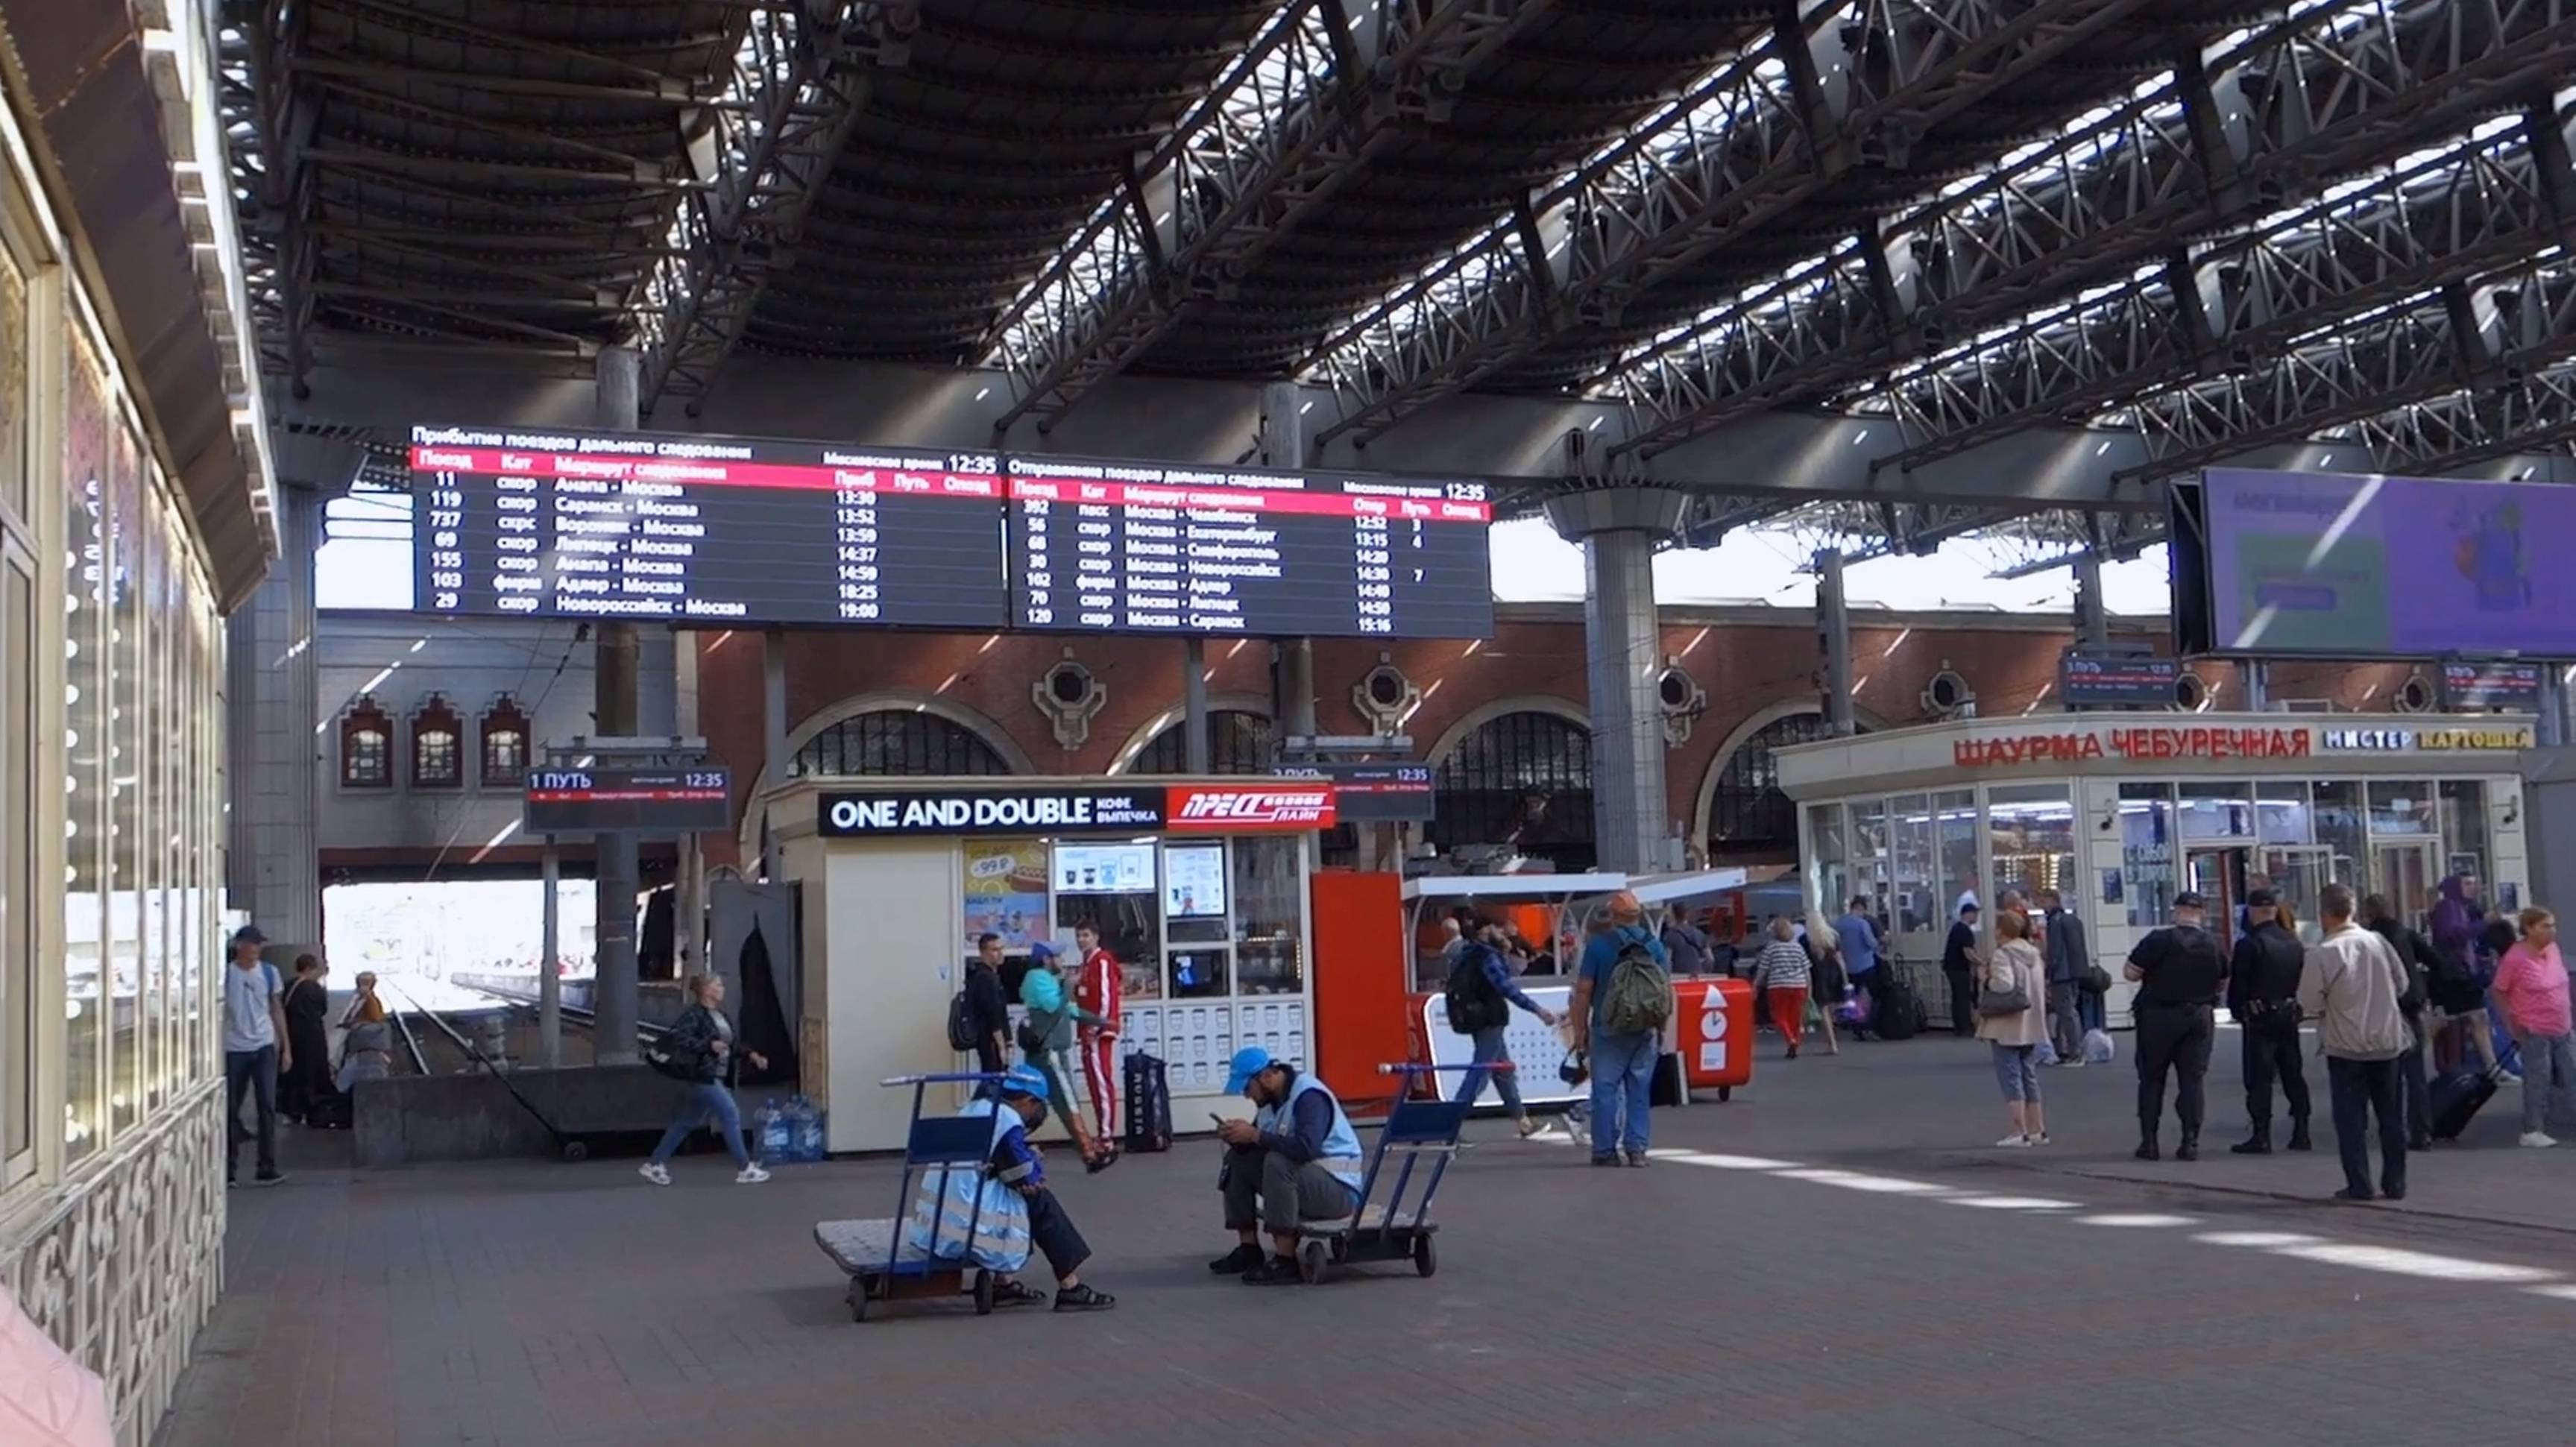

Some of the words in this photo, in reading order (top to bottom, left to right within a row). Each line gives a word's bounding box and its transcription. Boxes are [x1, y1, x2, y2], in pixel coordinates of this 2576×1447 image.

[412, 426, 503, 446] Прибытие
[506, 435, 577, 451] поездов
[578, 438, 655, 454] дальнего
[657, 443, 752, 459] следования
[419, 449, 473, 470] Поезд
[501, 454, 532, 470] Кат
[556, 456, 632, 479] Маршрут
[894, 473, 930, 492] Путь
[824, 451, 901, 468] Московское
[903, 458, 943, 470] время
[949, 455, 997, 474] 12:35
[1008, 459, 1103, 479] Отправление
[1105, 467, 1163, 482] поездов
[1163, 470, 1226, 485] дальнего
[1227, 474, 1304, 488] следования
[436, 470, 454, 486] 11
[497, 476, 538, 493] скор
[555, 477, 608, 493] Анапа
[622, 480, 683, 497] Москва
[837, 490, 876, 505] 13:30
[1446, 483, 1485, 501] 12:35
[432, 490, 462, 507] 119
[497, 496, 537, 513] скор
[555, 496, 624, 515] Саранск
[636, 497, 698, 517] Москва
[837, 508, 876, 525] 13:52
[1024, 499, 1049, 514] 392
[1124, 502, 1178, 520] Москва
[1355, 515, 1387, 530] 12:52
[1413, 518, 1421, 532] 3
[430, 511, 461, 527] 737
[555, 514, 630, 537] Воронеж
[643, 519, 705, 537] Москва
[837, 527, 877, 543] 13:59
[1028, 517, 1046, 532] 56
[1077, 523, 1111, 537] скор
[1125, 521, 1177, 537] Москва
[1355, 532, 1388, 547] 13:15
[1413, 535, 1422, 548] 4
[497, 537, 538, 553] скор
[555, 533, 618, 556] Липецк
[631, 538, 693, 555] Москва
[838, 546, 877, 562] 14:37
[1078, 540, 1112, 555] скор
[1126, 539, 1177, 555] Москва
[432, 551, 462, 567] 155
[497, 557, 538, 573] скор
[555, 552, 609, 572] Анапа
[623, 558, 684, 575] Москва
[838, 565, 878, 581] 14:59
[1079, 558, 1112, 574] скор
[1126, 557, 1178, 573] Москва
[1188, 560, 1281, 580] Новороссийск
[1414, 569, 1423, 581] 7
[432, 572, 462, 588] 103
[493, 573, 543, 593] фирм
[555, 575, 610, 597] Адлер
[623, 577, 684, 594] Москва
[839, 584, 878, 599] 18:25
[1027, 572, 1051, 587] 102
[1127, 576, 1178, 590] Москва
[1188, 576, 1231, 597] Адлер
[436, 592, 458, 608] 29
[497, 596, 538, 613] скор
[556, 593, 673, 614] Новороссийск
[686, 599, 746, 616] Москва
[839, 602, 878, 618] 19:00
[1030, 590, 1048, 605] 70
[1080, 595, 1113, 610] скор
[1127, 593, 1179, 609] Москва
[1027, 608, 1052, 623] 120
[1080, 613, 1114, 627] скор
[1127, 611, 1180, 626] Москва
[1953, 733, 2103, 768] ШАУРМА
[2110, 727, 2311, 760] ЧЕБУРЕЧНАЯ
[2325, 729, 2411, 749] МИСТЕР
[2418, 728, 2532, 749] КАРТОШКА
[531, 774, 539, 789] 1
[544, 773, 592, 788] ПУТЬ
[685, 774, 723, 787] 12:35
[1397, 768, 1428, 781] 12:35
[831, 800, 898, 828] ONE
[901, 799, 971, 827] AND
[974, 797, 1091, 825] DOUBLE
[1096, 797, 1132, 810] КОФЕ
[1096, 810, 1158, 825] ВЫПЕЧКА
